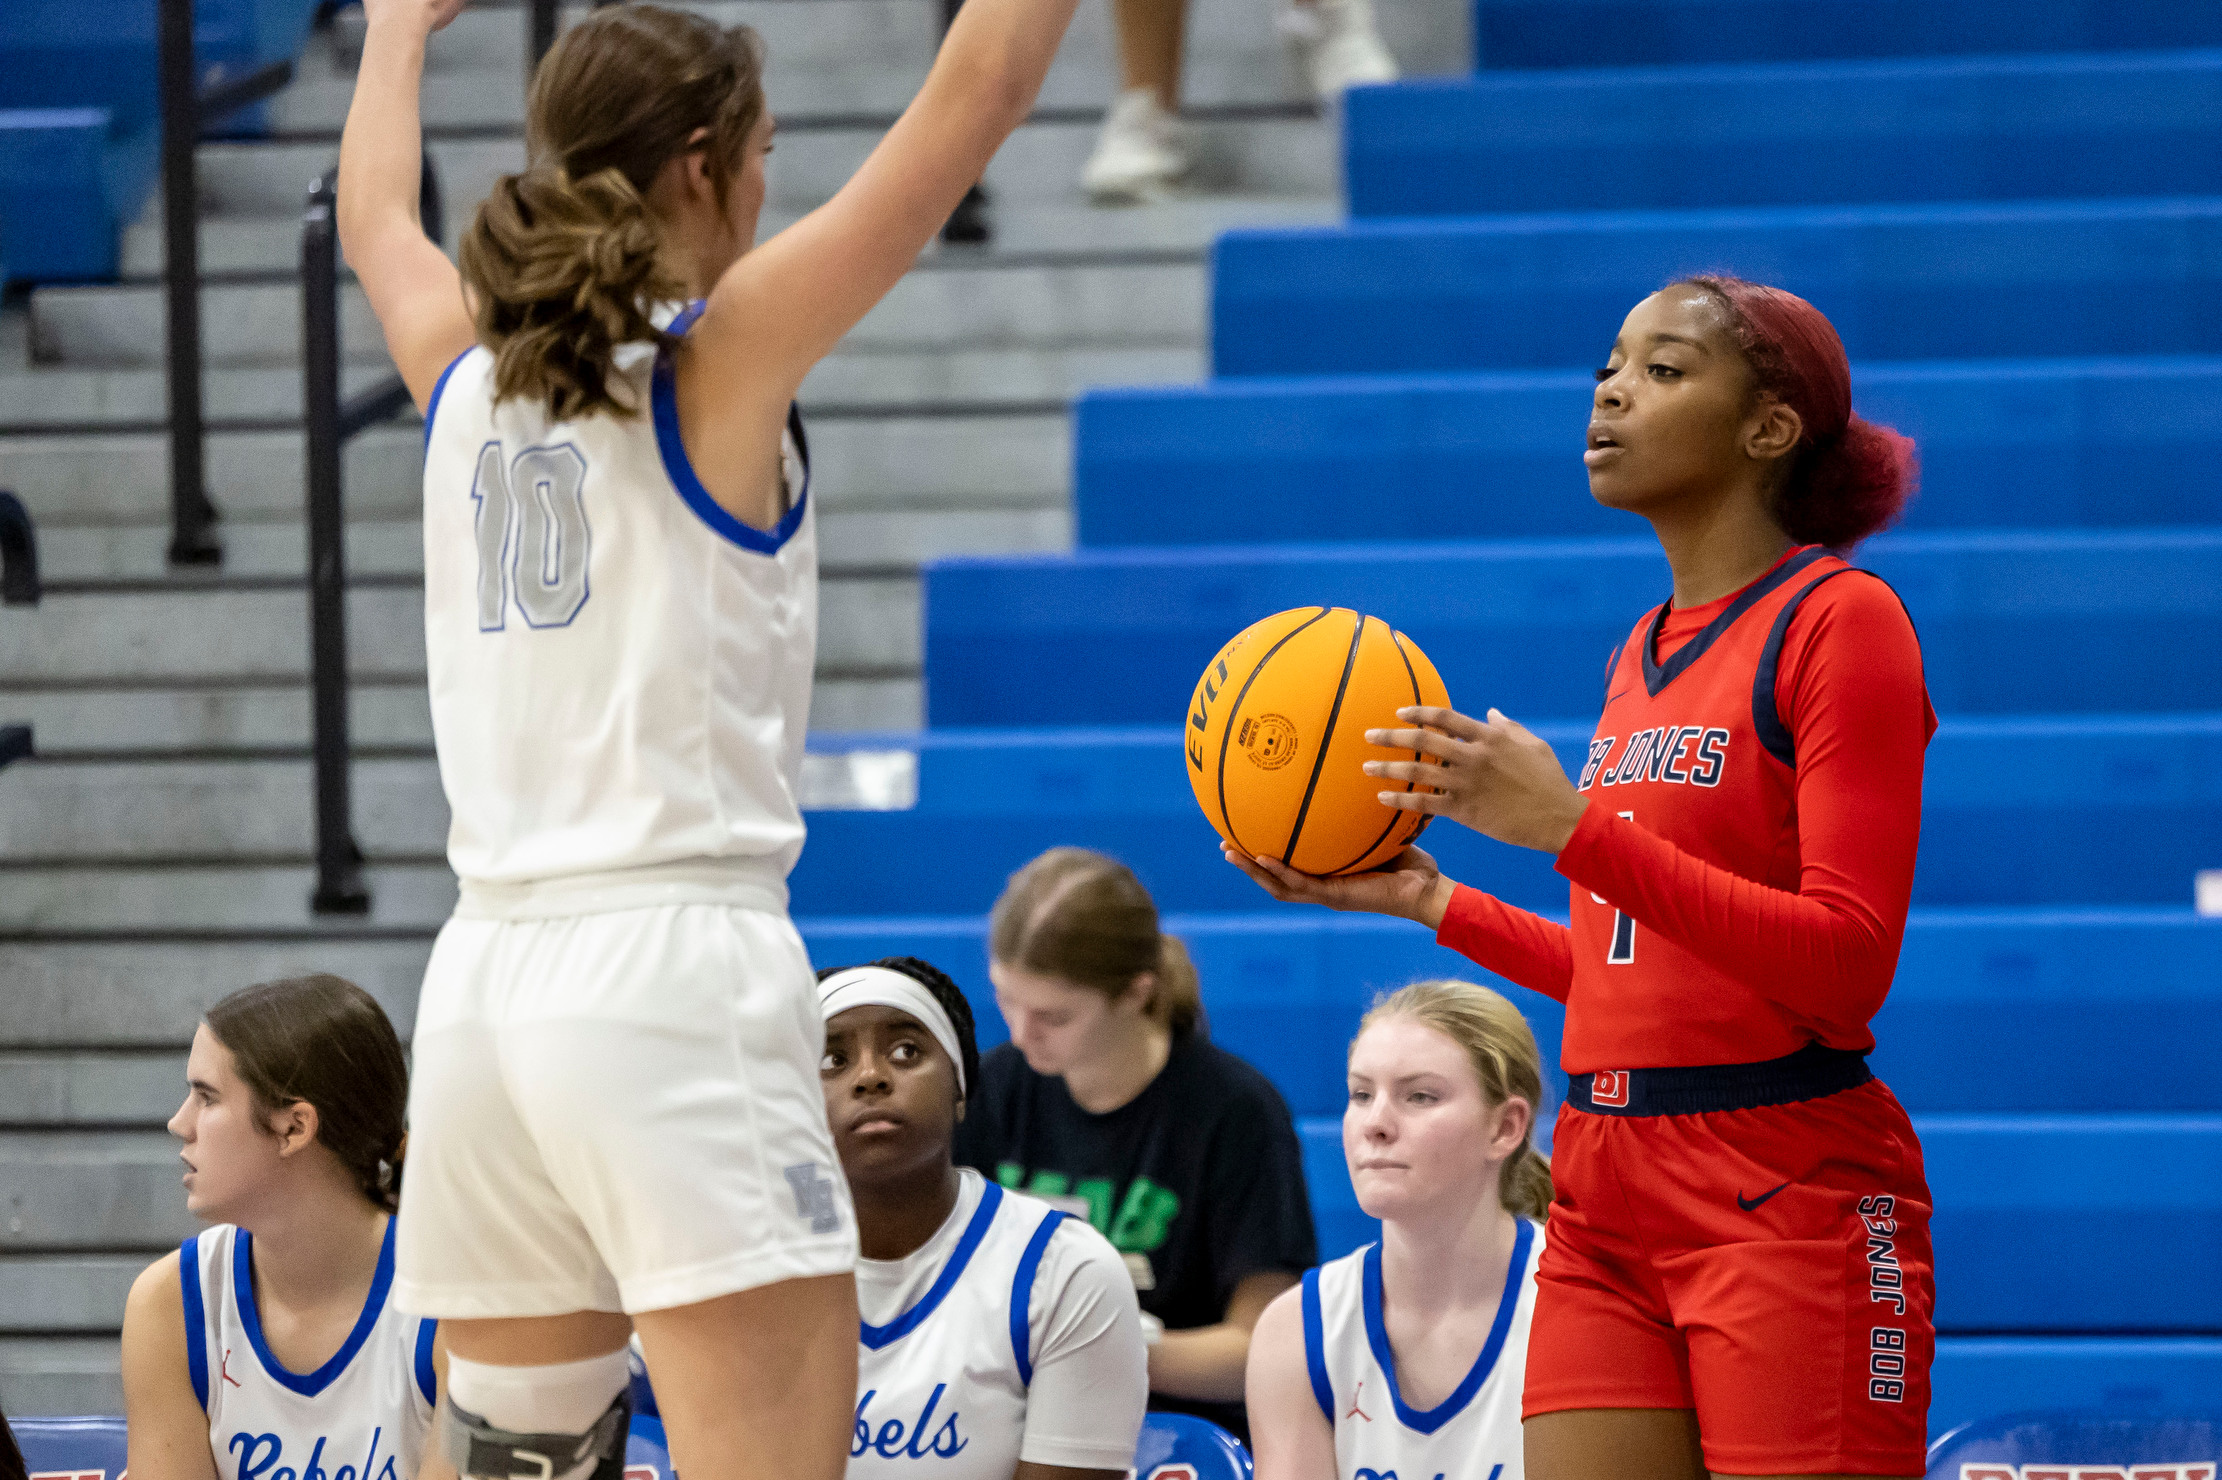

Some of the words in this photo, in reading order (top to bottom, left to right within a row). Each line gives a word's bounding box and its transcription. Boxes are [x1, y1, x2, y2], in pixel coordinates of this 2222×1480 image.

[470, 439, 592, 632] 10
[1188, 658, 1228, 773] EVO
[1601, 725, 1730, 788] JONES
[1856, 1195, 1906, 1316] JONES
[1868, 1326, 1906, 1404] BOB
